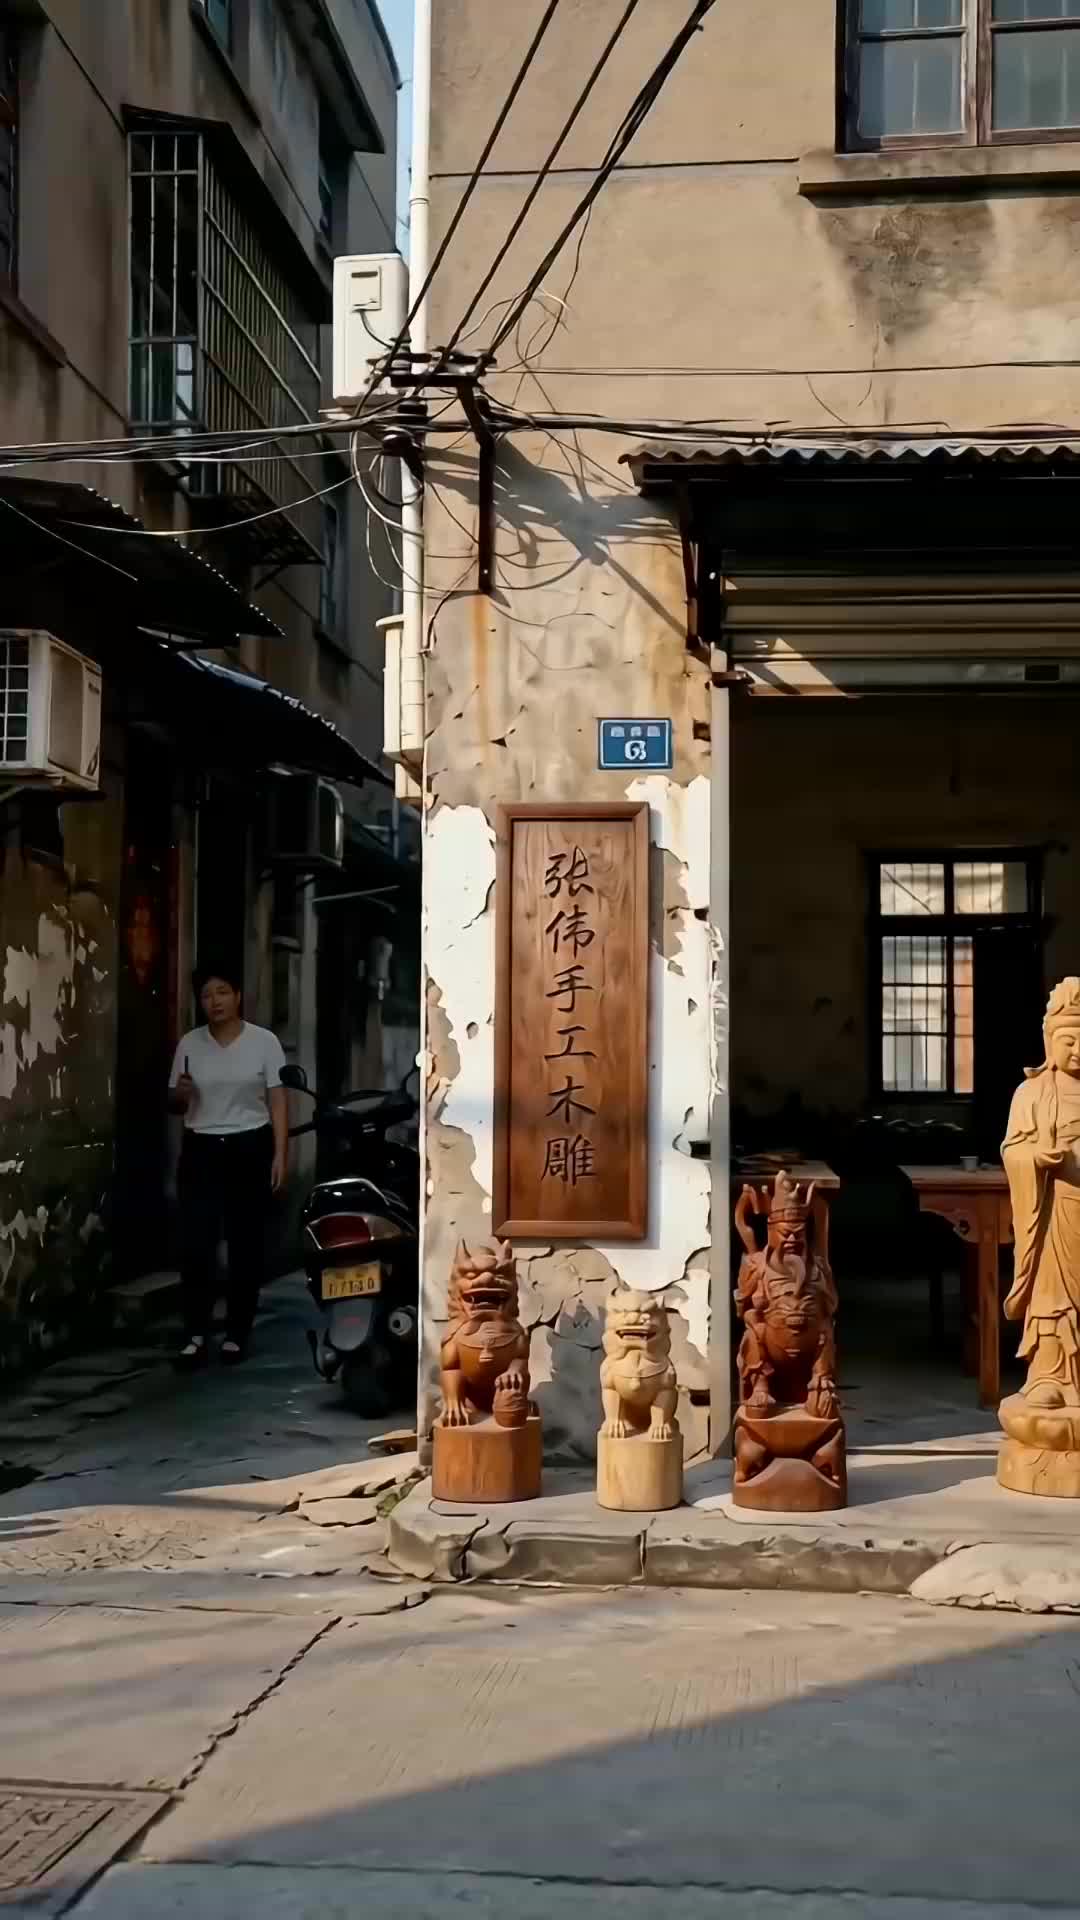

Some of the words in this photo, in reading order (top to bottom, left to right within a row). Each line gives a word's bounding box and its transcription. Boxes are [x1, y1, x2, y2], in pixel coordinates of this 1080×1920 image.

[542, 846, 597, 1187] 张伟手工木雕
